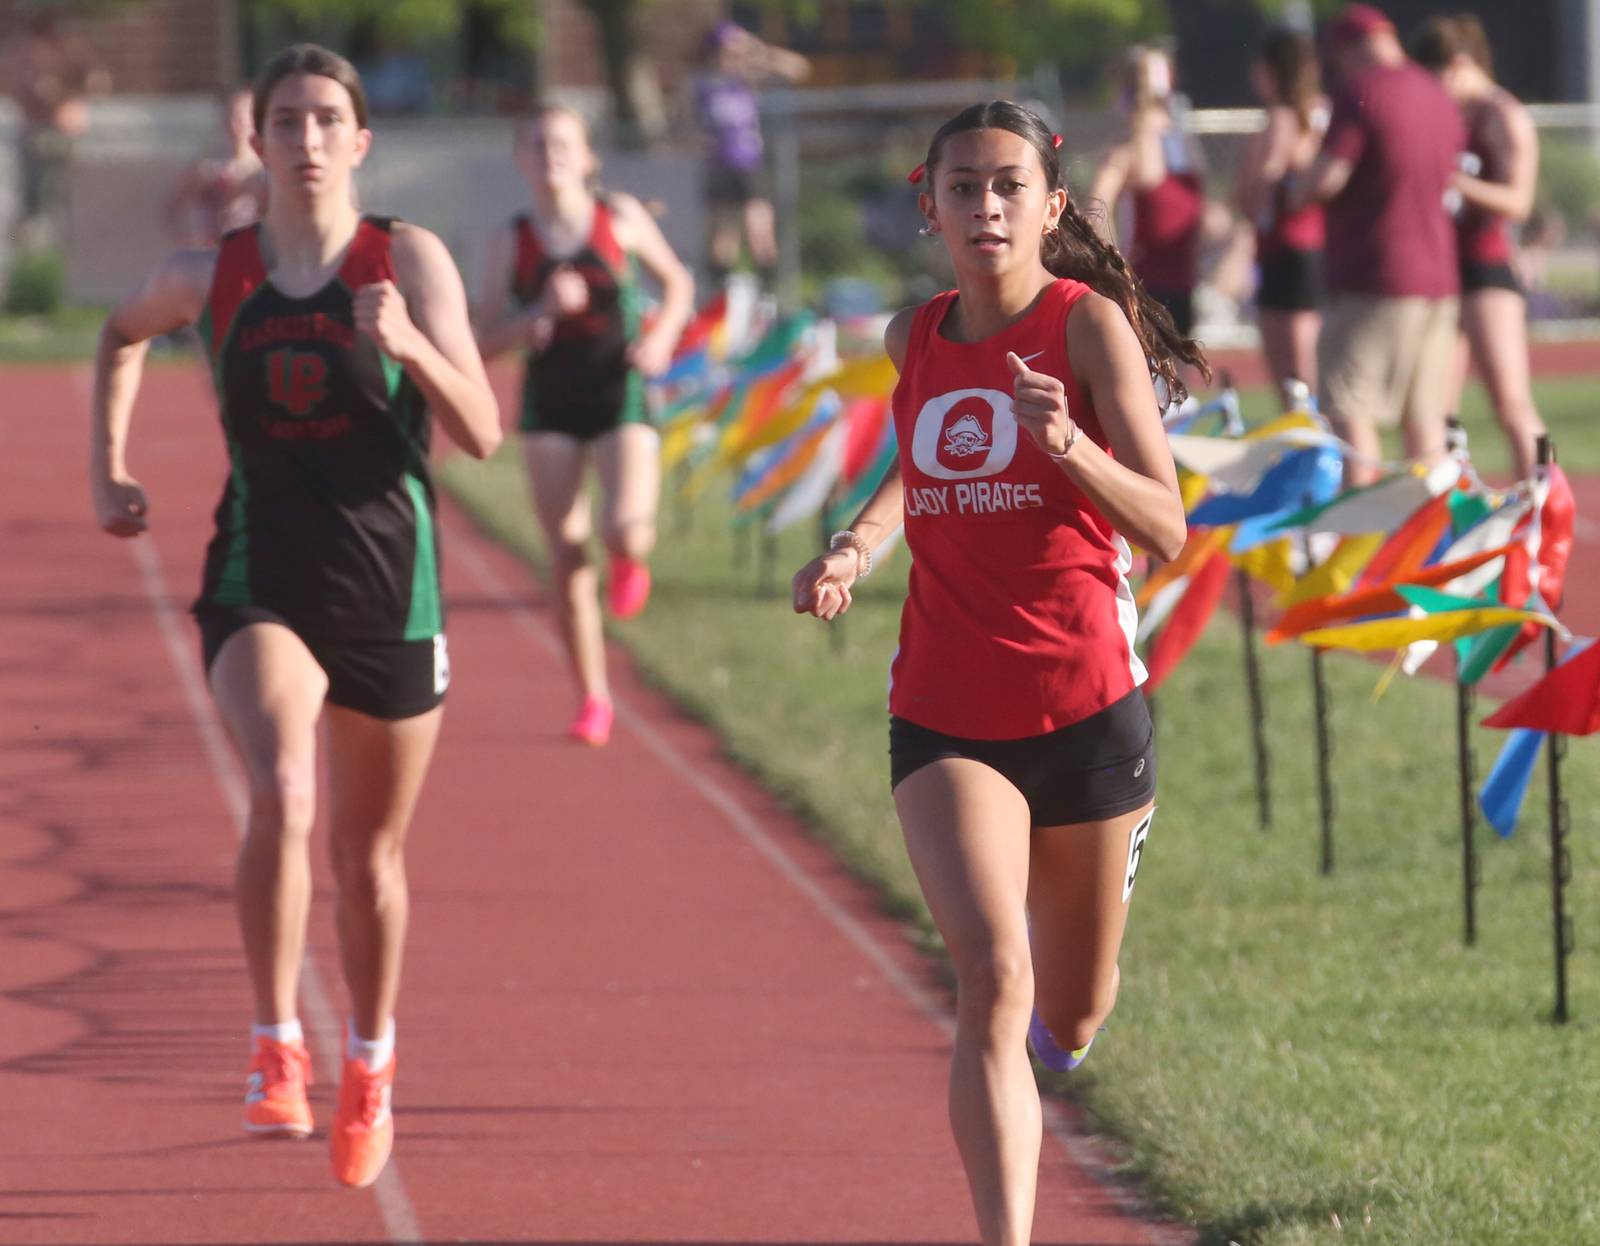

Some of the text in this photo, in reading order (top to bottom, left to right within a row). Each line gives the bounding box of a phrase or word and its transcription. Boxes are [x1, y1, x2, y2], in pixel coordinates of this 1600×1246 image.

[912, 388, 1018, 480] O
[904, 482, 1043, 517] LADY PIRATES
